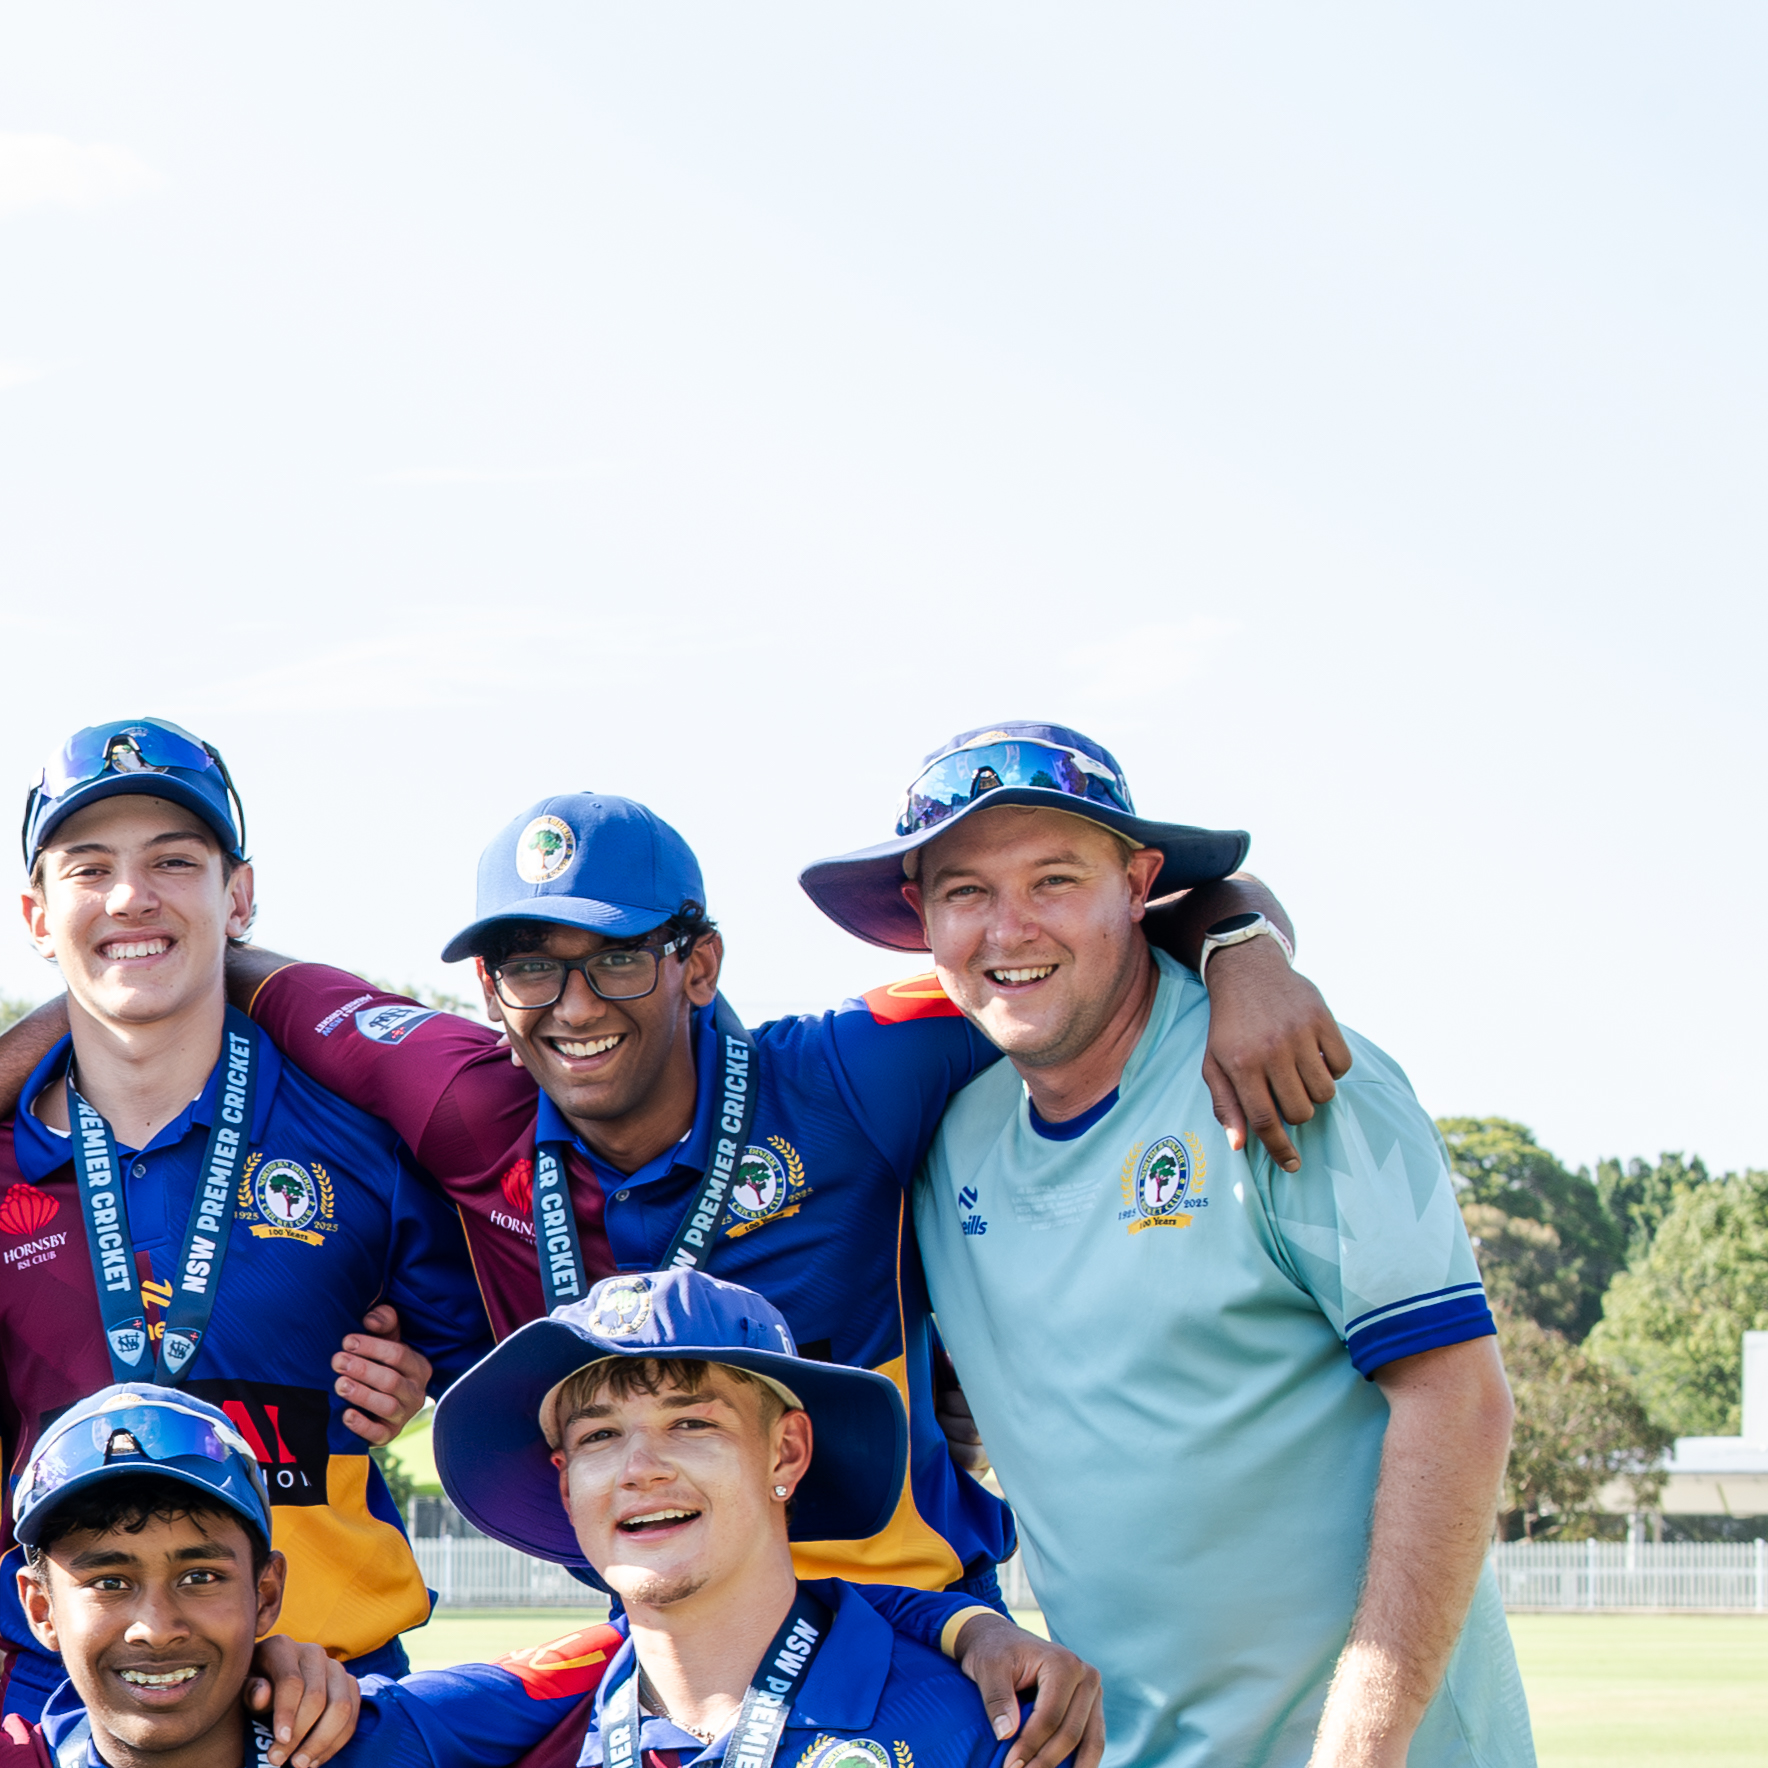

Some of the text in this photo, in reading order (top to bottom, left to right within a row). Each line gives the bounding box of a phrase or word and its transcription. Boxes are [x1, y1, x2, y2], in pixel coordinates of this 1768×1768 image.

[686, 1035, 749, 1249] PREMIER CRICKET
[182, 1032, 251, 1294] NSW PREMIER CRICKET
[1183, 1197, 1209, 1209] 2025
[235, 1210, 339, 1232] 1925 2025
[267, 1227, 310, 1242] 100 Years
[1139, 1217, 1177, 1229] 100 Years
[3, 1231, 68, 1264] HORNSBY
[91, 1191, 131, 1292] CRICKET
[541, 1192, 580, 1297] CRICKET
[18, 1250, 57, 1271] RSL CLUB
[783, 1618, 820, 1678] NSW
